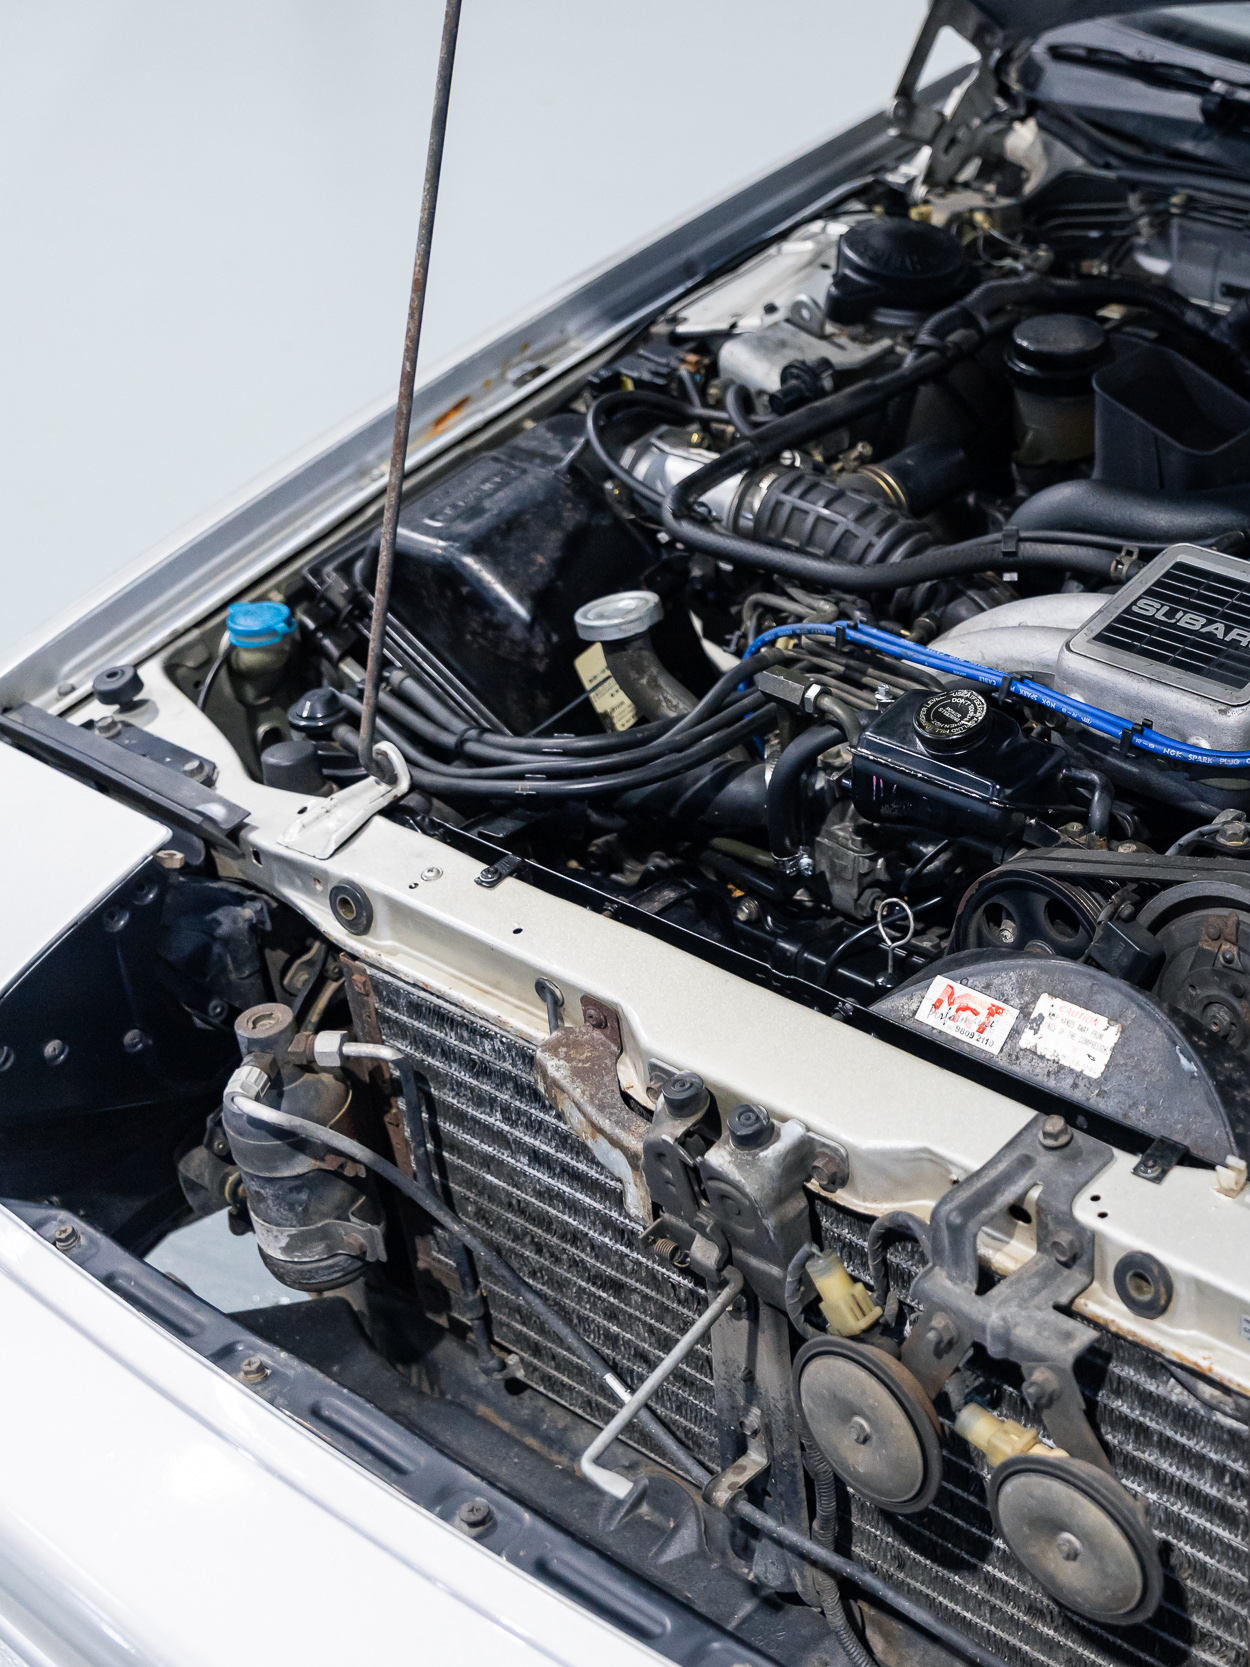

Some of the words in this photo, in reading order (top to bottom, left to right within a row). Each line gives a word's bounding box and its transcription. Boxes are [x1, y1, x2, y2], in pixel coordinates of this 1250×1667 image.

[1163, 748, 1182, 758] NGK
[1188, 754, 1212, 764] SPARK
[1059, 1004, 1099, 1026] CAUTION
[955, 1026, 974, 1038] 9809
[976, 1036, 994, 1046] 2110
[1061, 1018, 1075, 1028] HANDS
[1077, 1024, 1088, 1032] AWAY
[1091, 1028, 1104, 1038] FROM
[1068, 1030, 1076, 1038] THE
